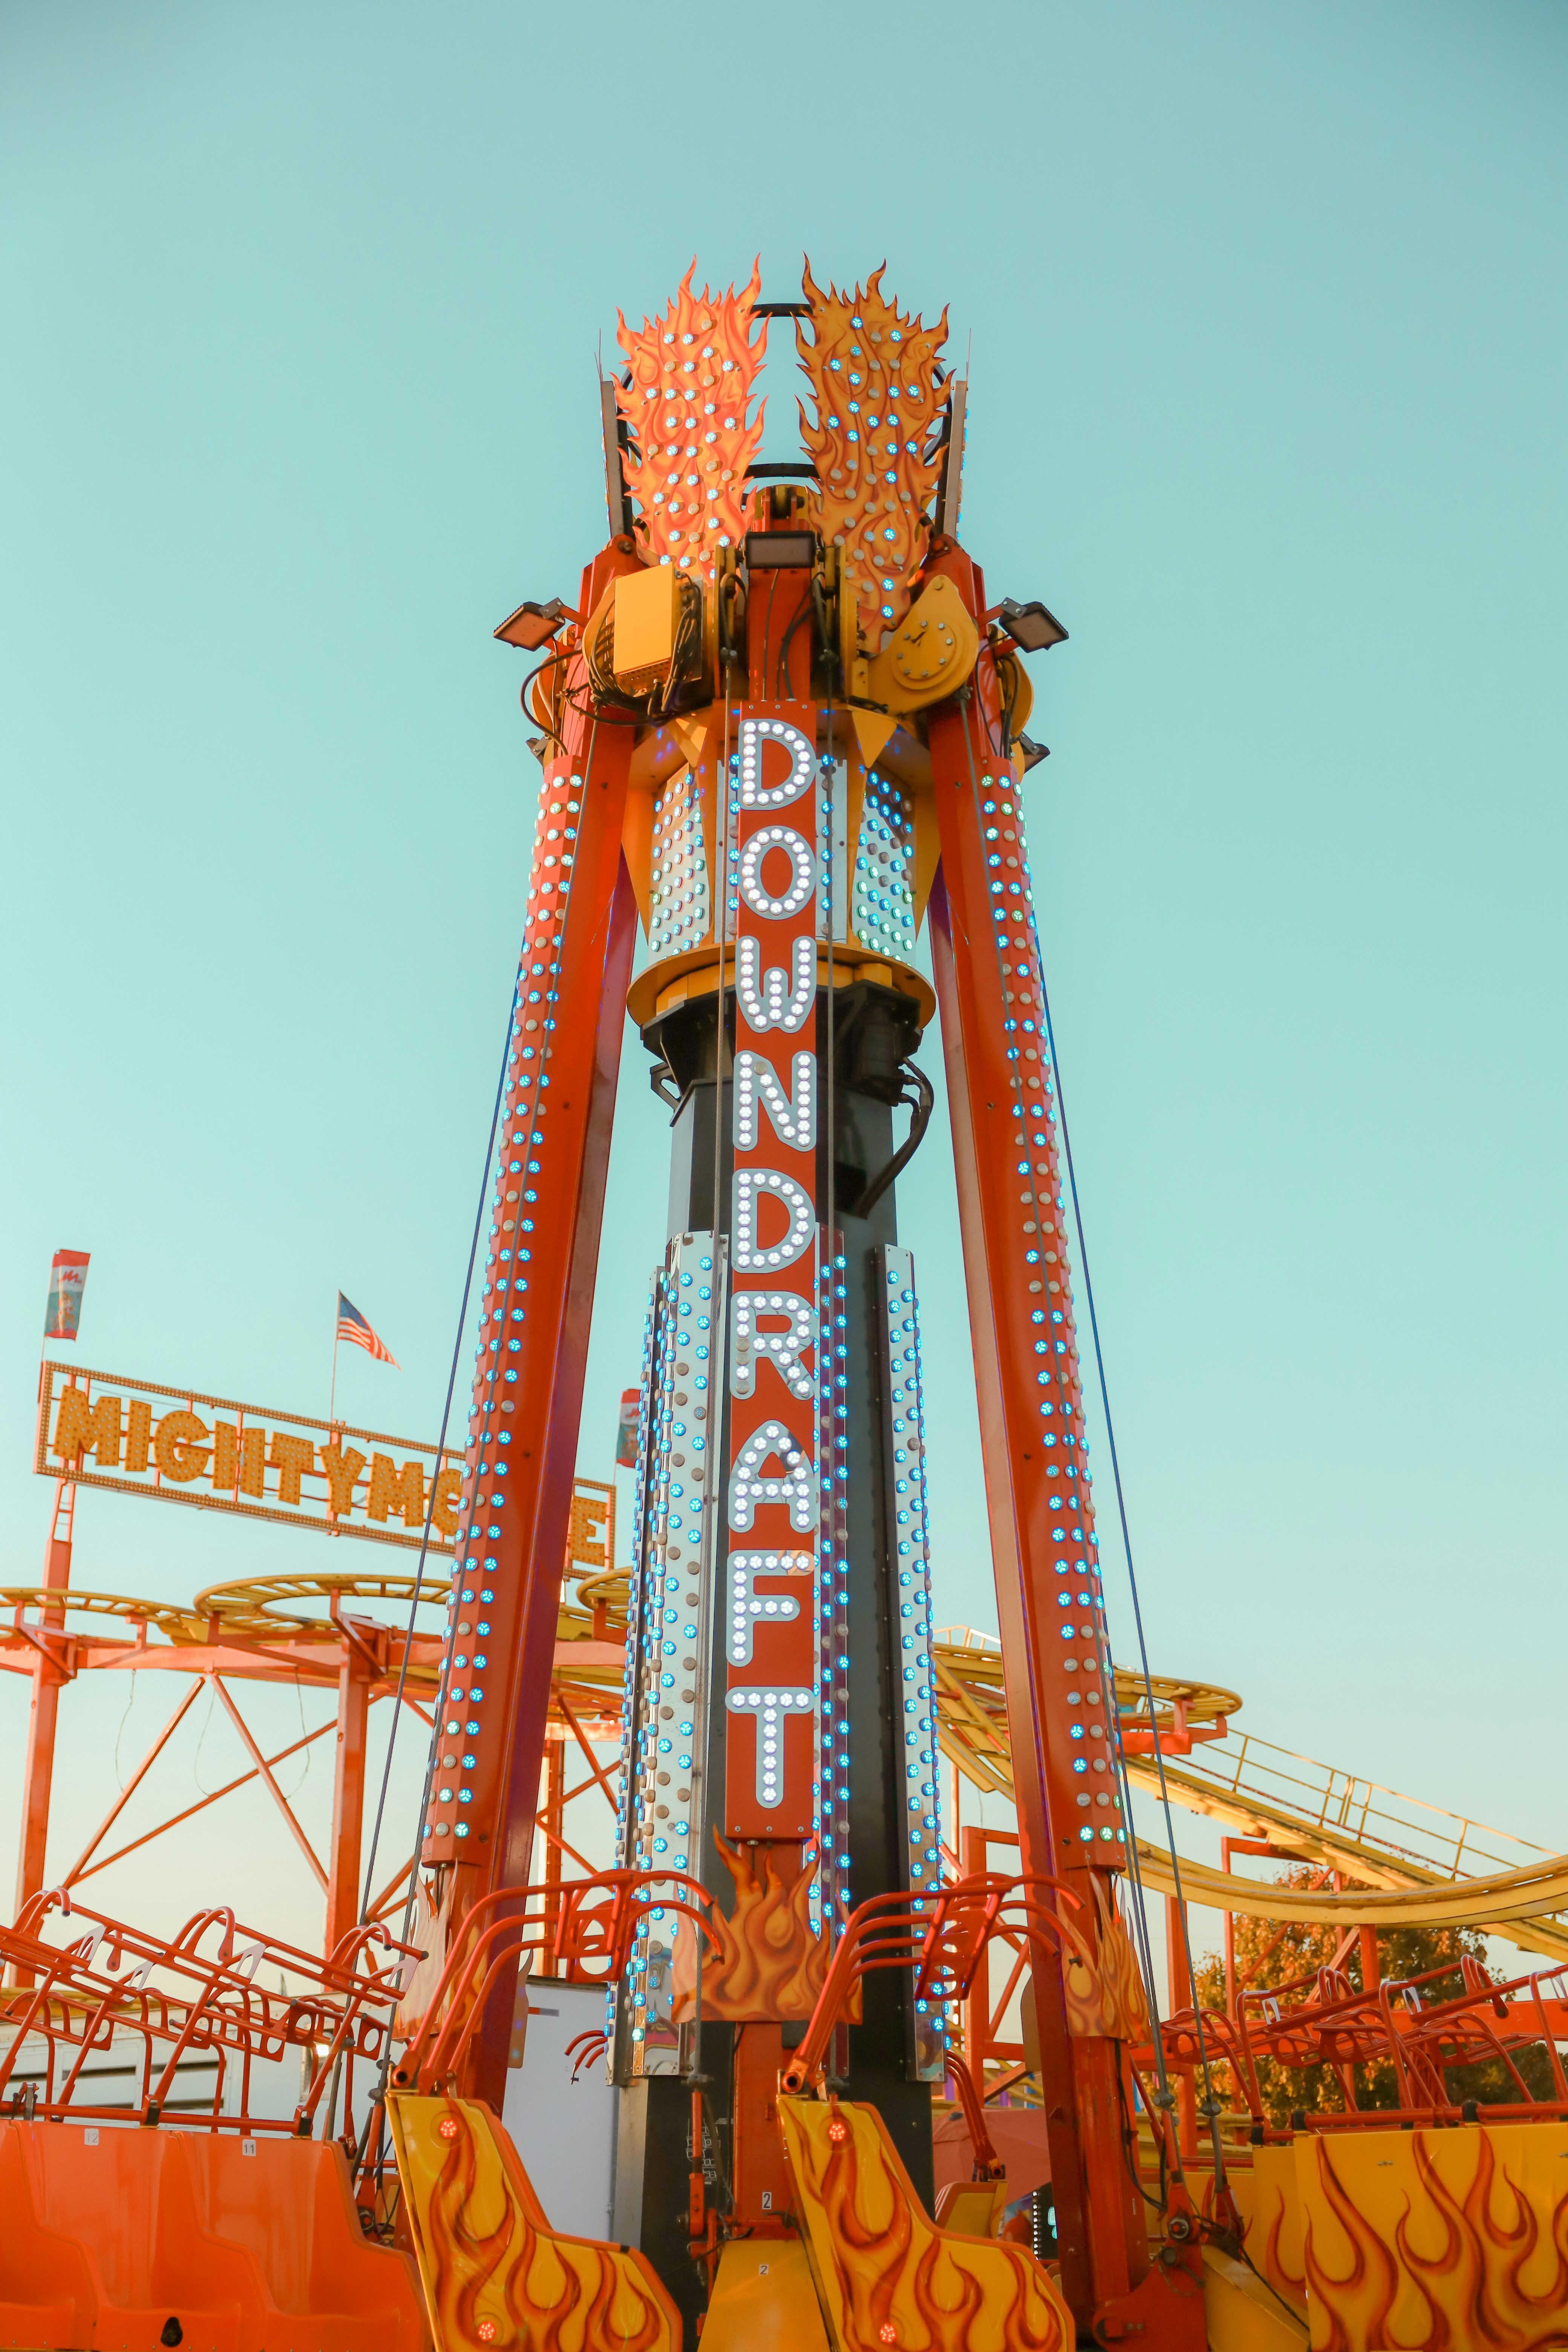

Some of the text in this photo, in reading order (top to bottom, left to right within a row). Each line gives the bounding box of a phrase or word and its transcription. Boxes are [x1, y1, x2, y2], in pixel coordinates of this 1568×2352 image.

[724, 719, 818, 1808] DOWNDRAFT
[86, 2133, 98, 2143] 12
[244, 2144, 254, 2154] 11
[763, 2193, 770, 2208] 2
[760, 2265, 767, 2275] 2
